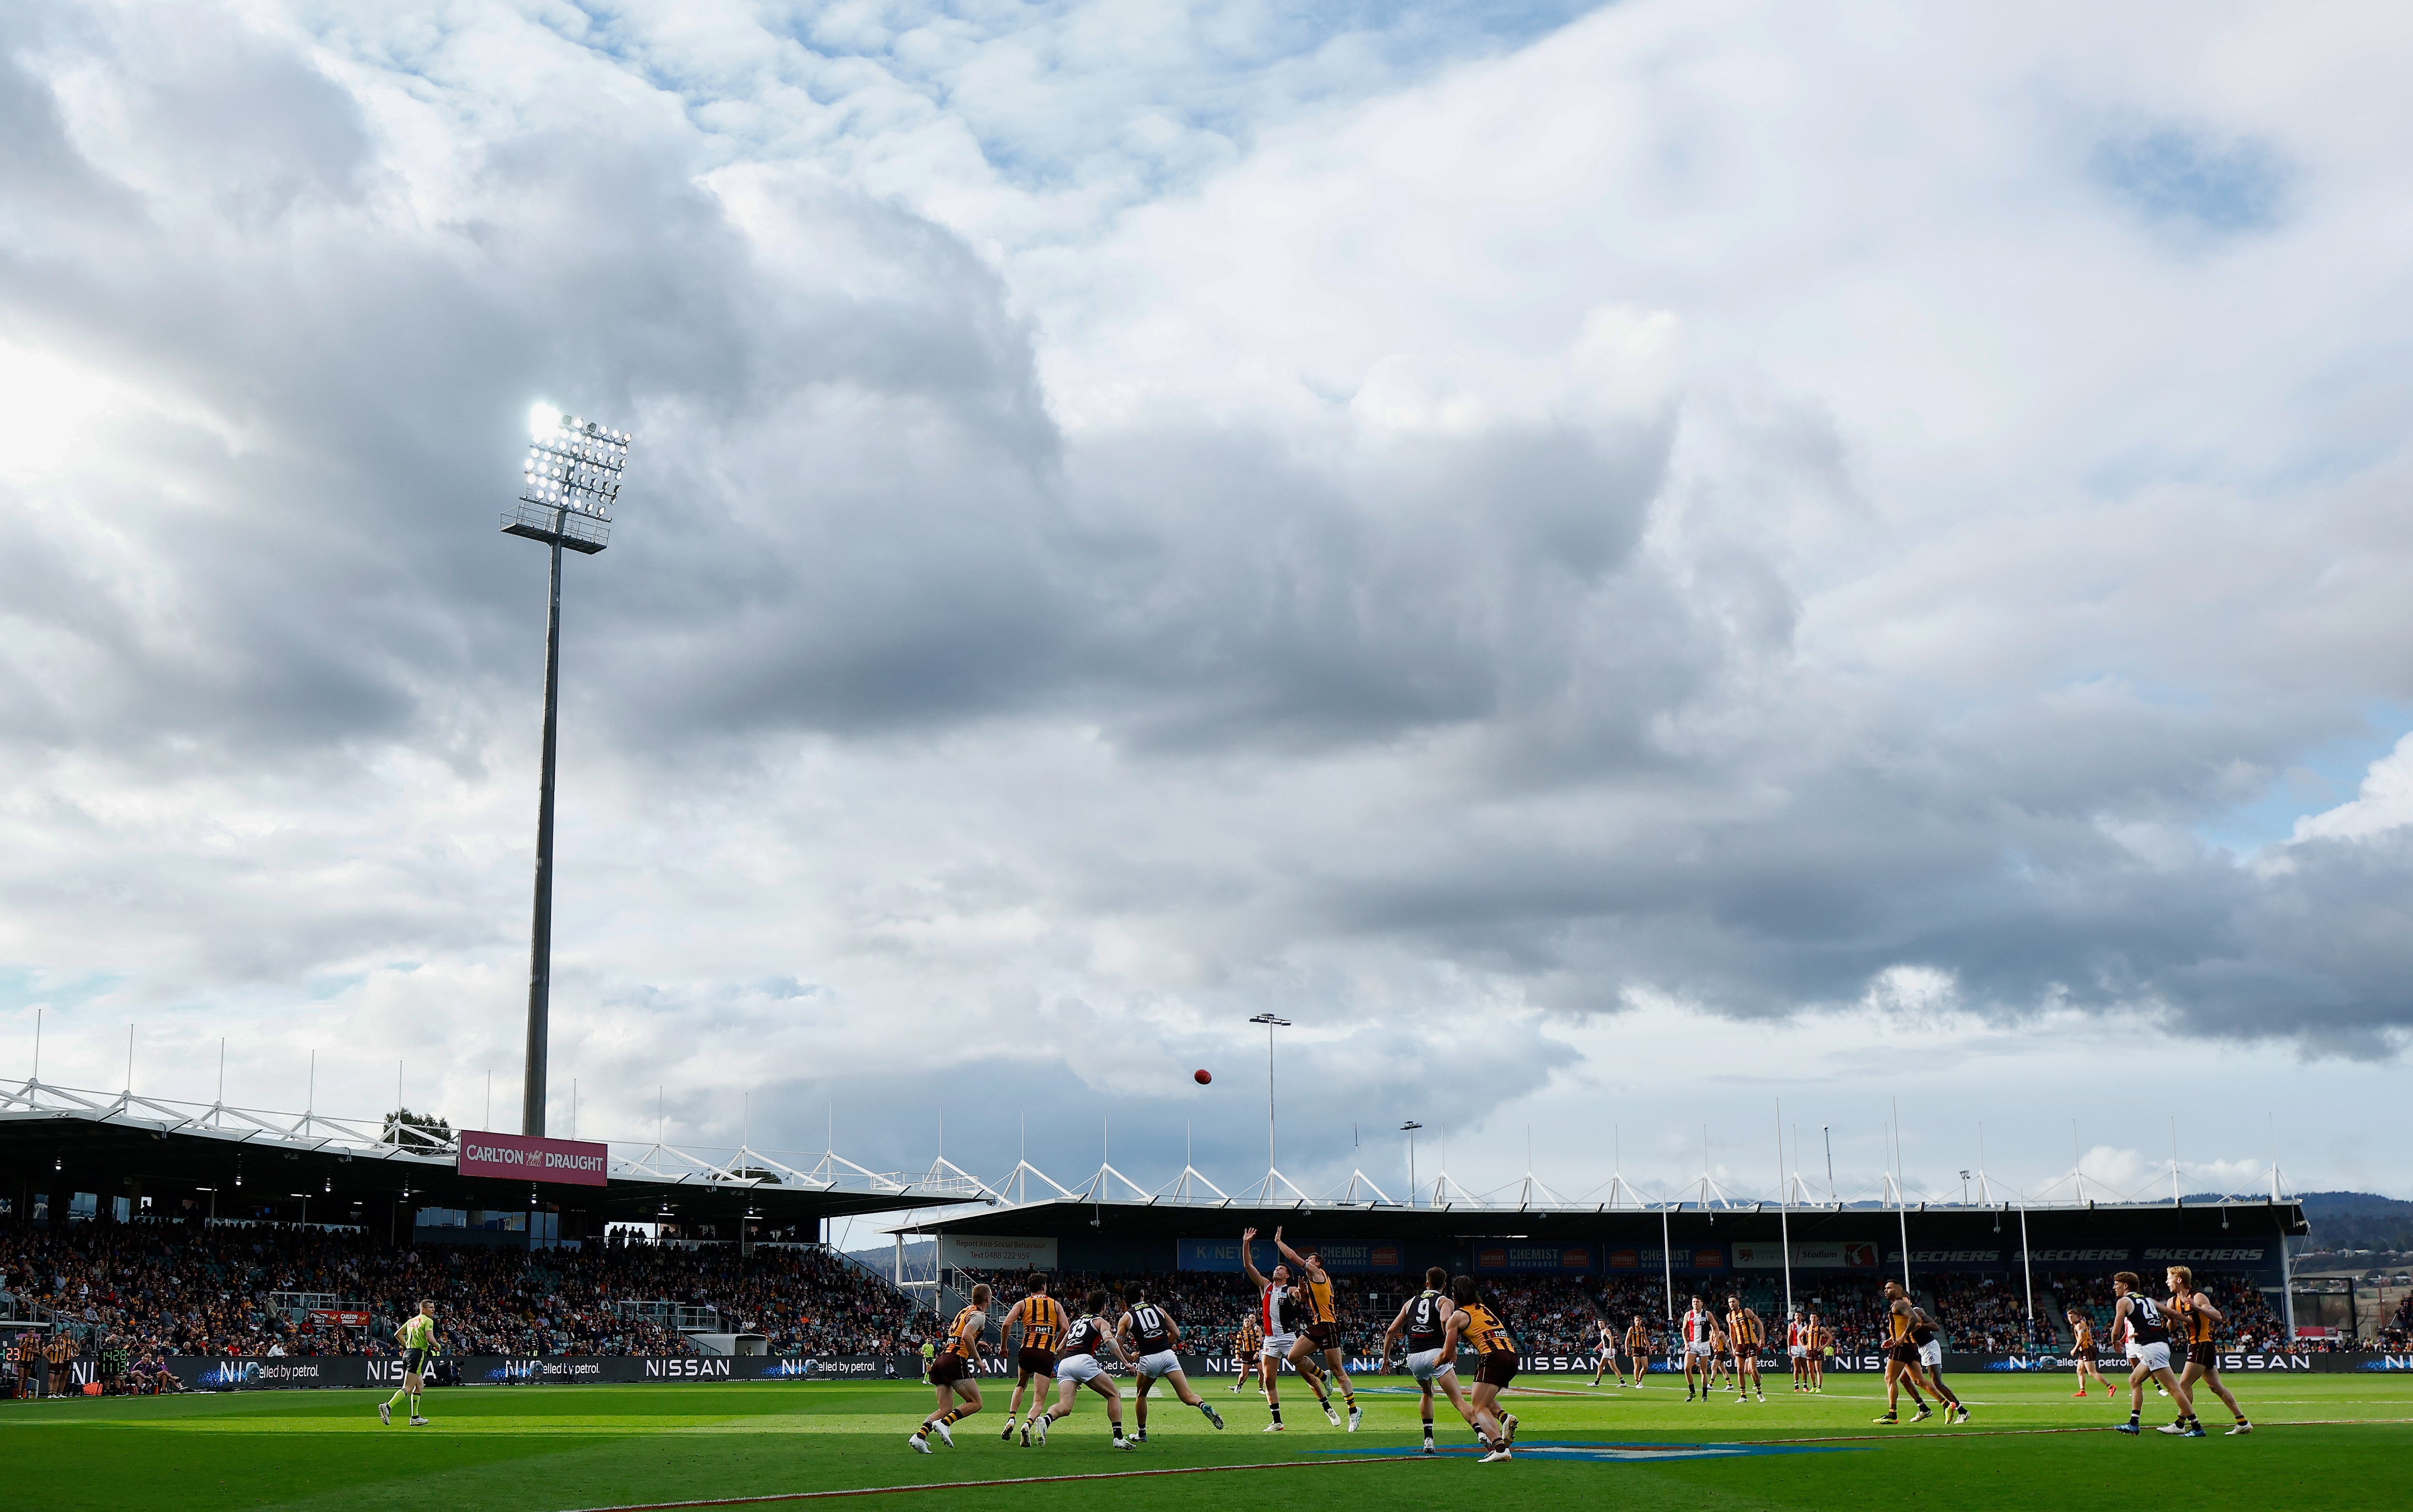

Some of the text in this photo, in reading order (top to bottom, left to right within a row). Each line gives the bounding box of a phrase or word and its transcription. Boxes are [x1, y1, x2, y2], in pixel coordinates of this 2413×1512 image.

[466, 1144, 603, 1171] CARLTON DRAUGHT
[1320, 1247, 1368, 1258] CHEMIST
[1510, 1249, 1558, 1260] CHEMIST
[1886, 1251, 2000, 1262] SKECHERS
[2013, 1249, 2129, 1262] SKECHERS
[2143, 1248, 2264, 1261] SKECHERS
[1032, 1300, 1049, 1323] 11
[1415, 1298, 1430, 1324] 9
[1475, 1303, 1499, 1327] 3
[2136, 1297, 2160, 1320] 24
[1136, 1308, 1160, 1332] 10
[1068, 1318, 1090, 1340] 35
[543, 1362, 562, 1374] elled
[575, 1362, 600, 1375] petrol.
[646, 1359, 729, 1376] NISSAN
[818, 1361, 876, 1374] elled by petrol.
[1393, 1360, 1402, 1368] ell
[1756, 1359, 1779, 1367] etrol.
[1835, 1356, 1881, 1370] NIS
[2216, 1355, 2310, 1369] ISSAN
[259, 1364, 319, 1380] elled by petrol.
[367, 1361, 453, 1380] NISA
